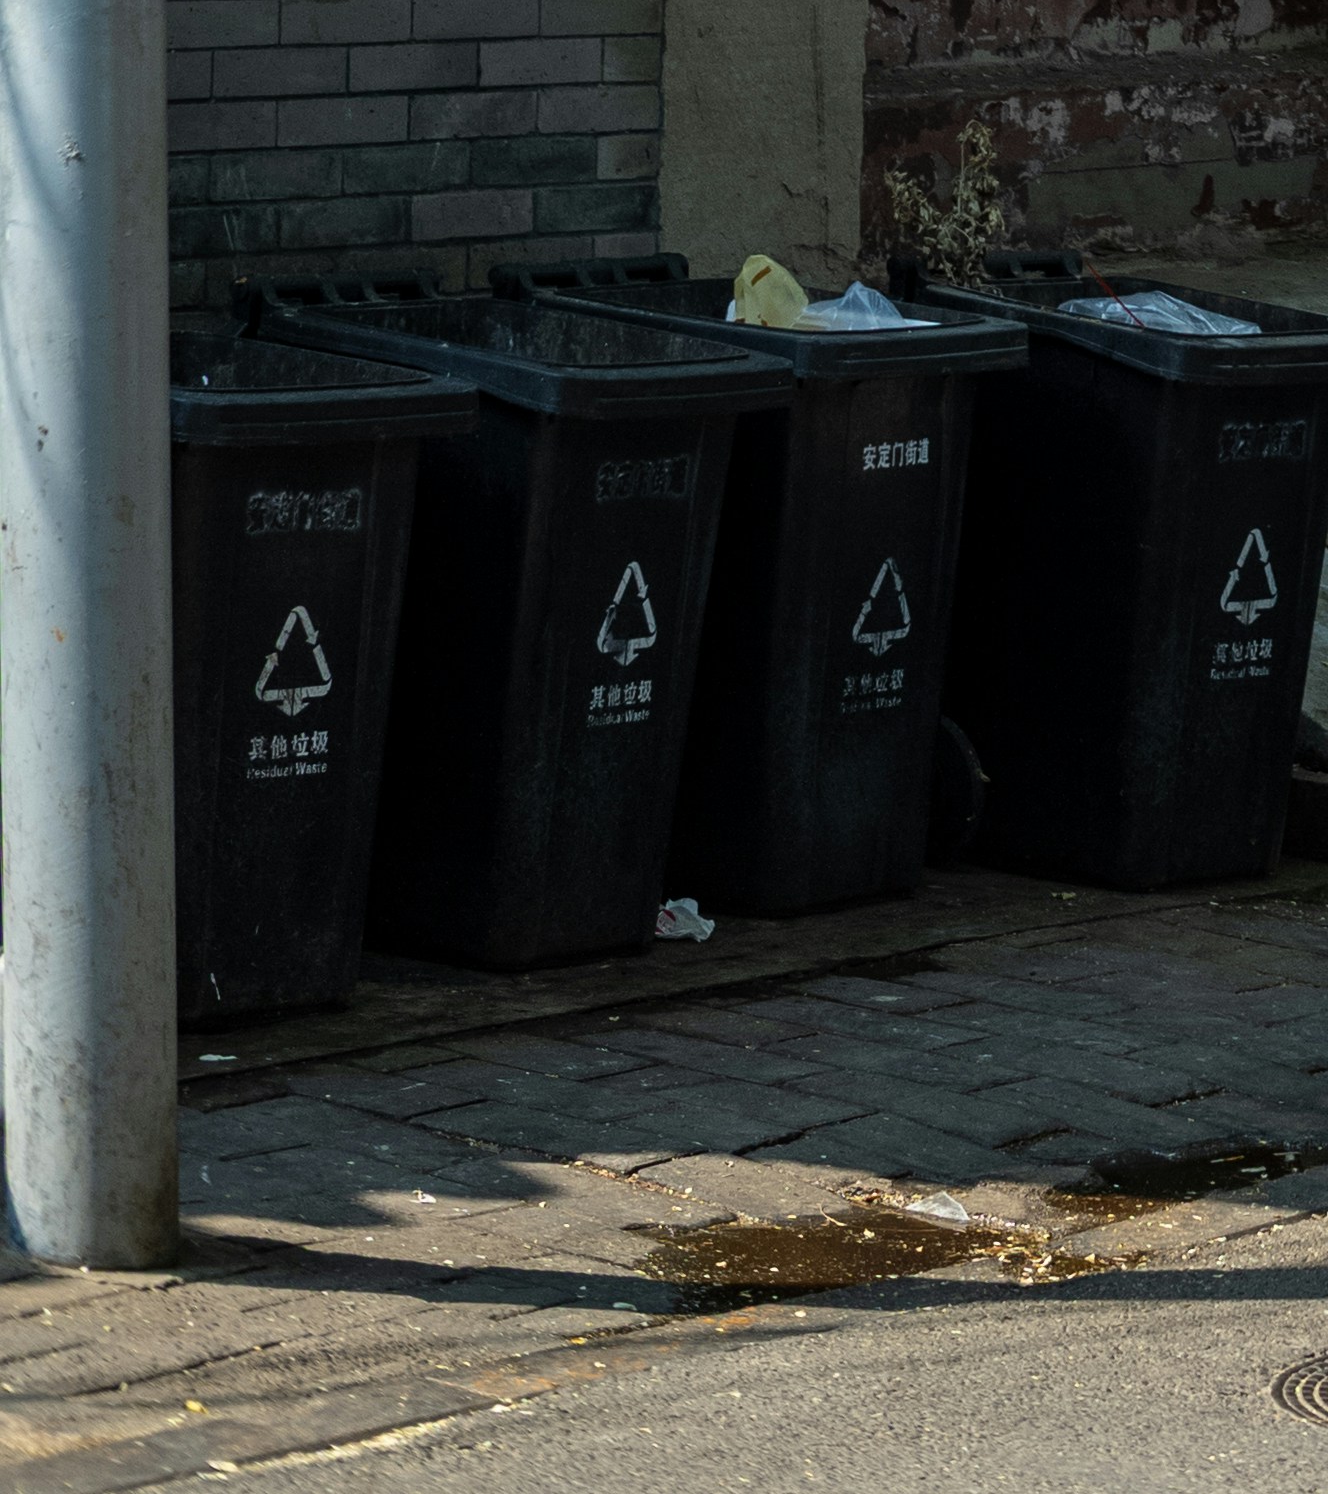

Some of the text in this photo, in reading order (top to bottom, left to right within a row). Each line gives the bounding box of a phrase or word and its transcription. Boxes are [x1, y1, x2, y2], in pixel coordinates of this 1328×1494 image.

[861, 437, 931, 471] 安定门街道
[589, 679, 653, 711] 其他垃圾
[246, 729, 330, 762] 其他垃圾
[294, 760, 328, 778] Waste
